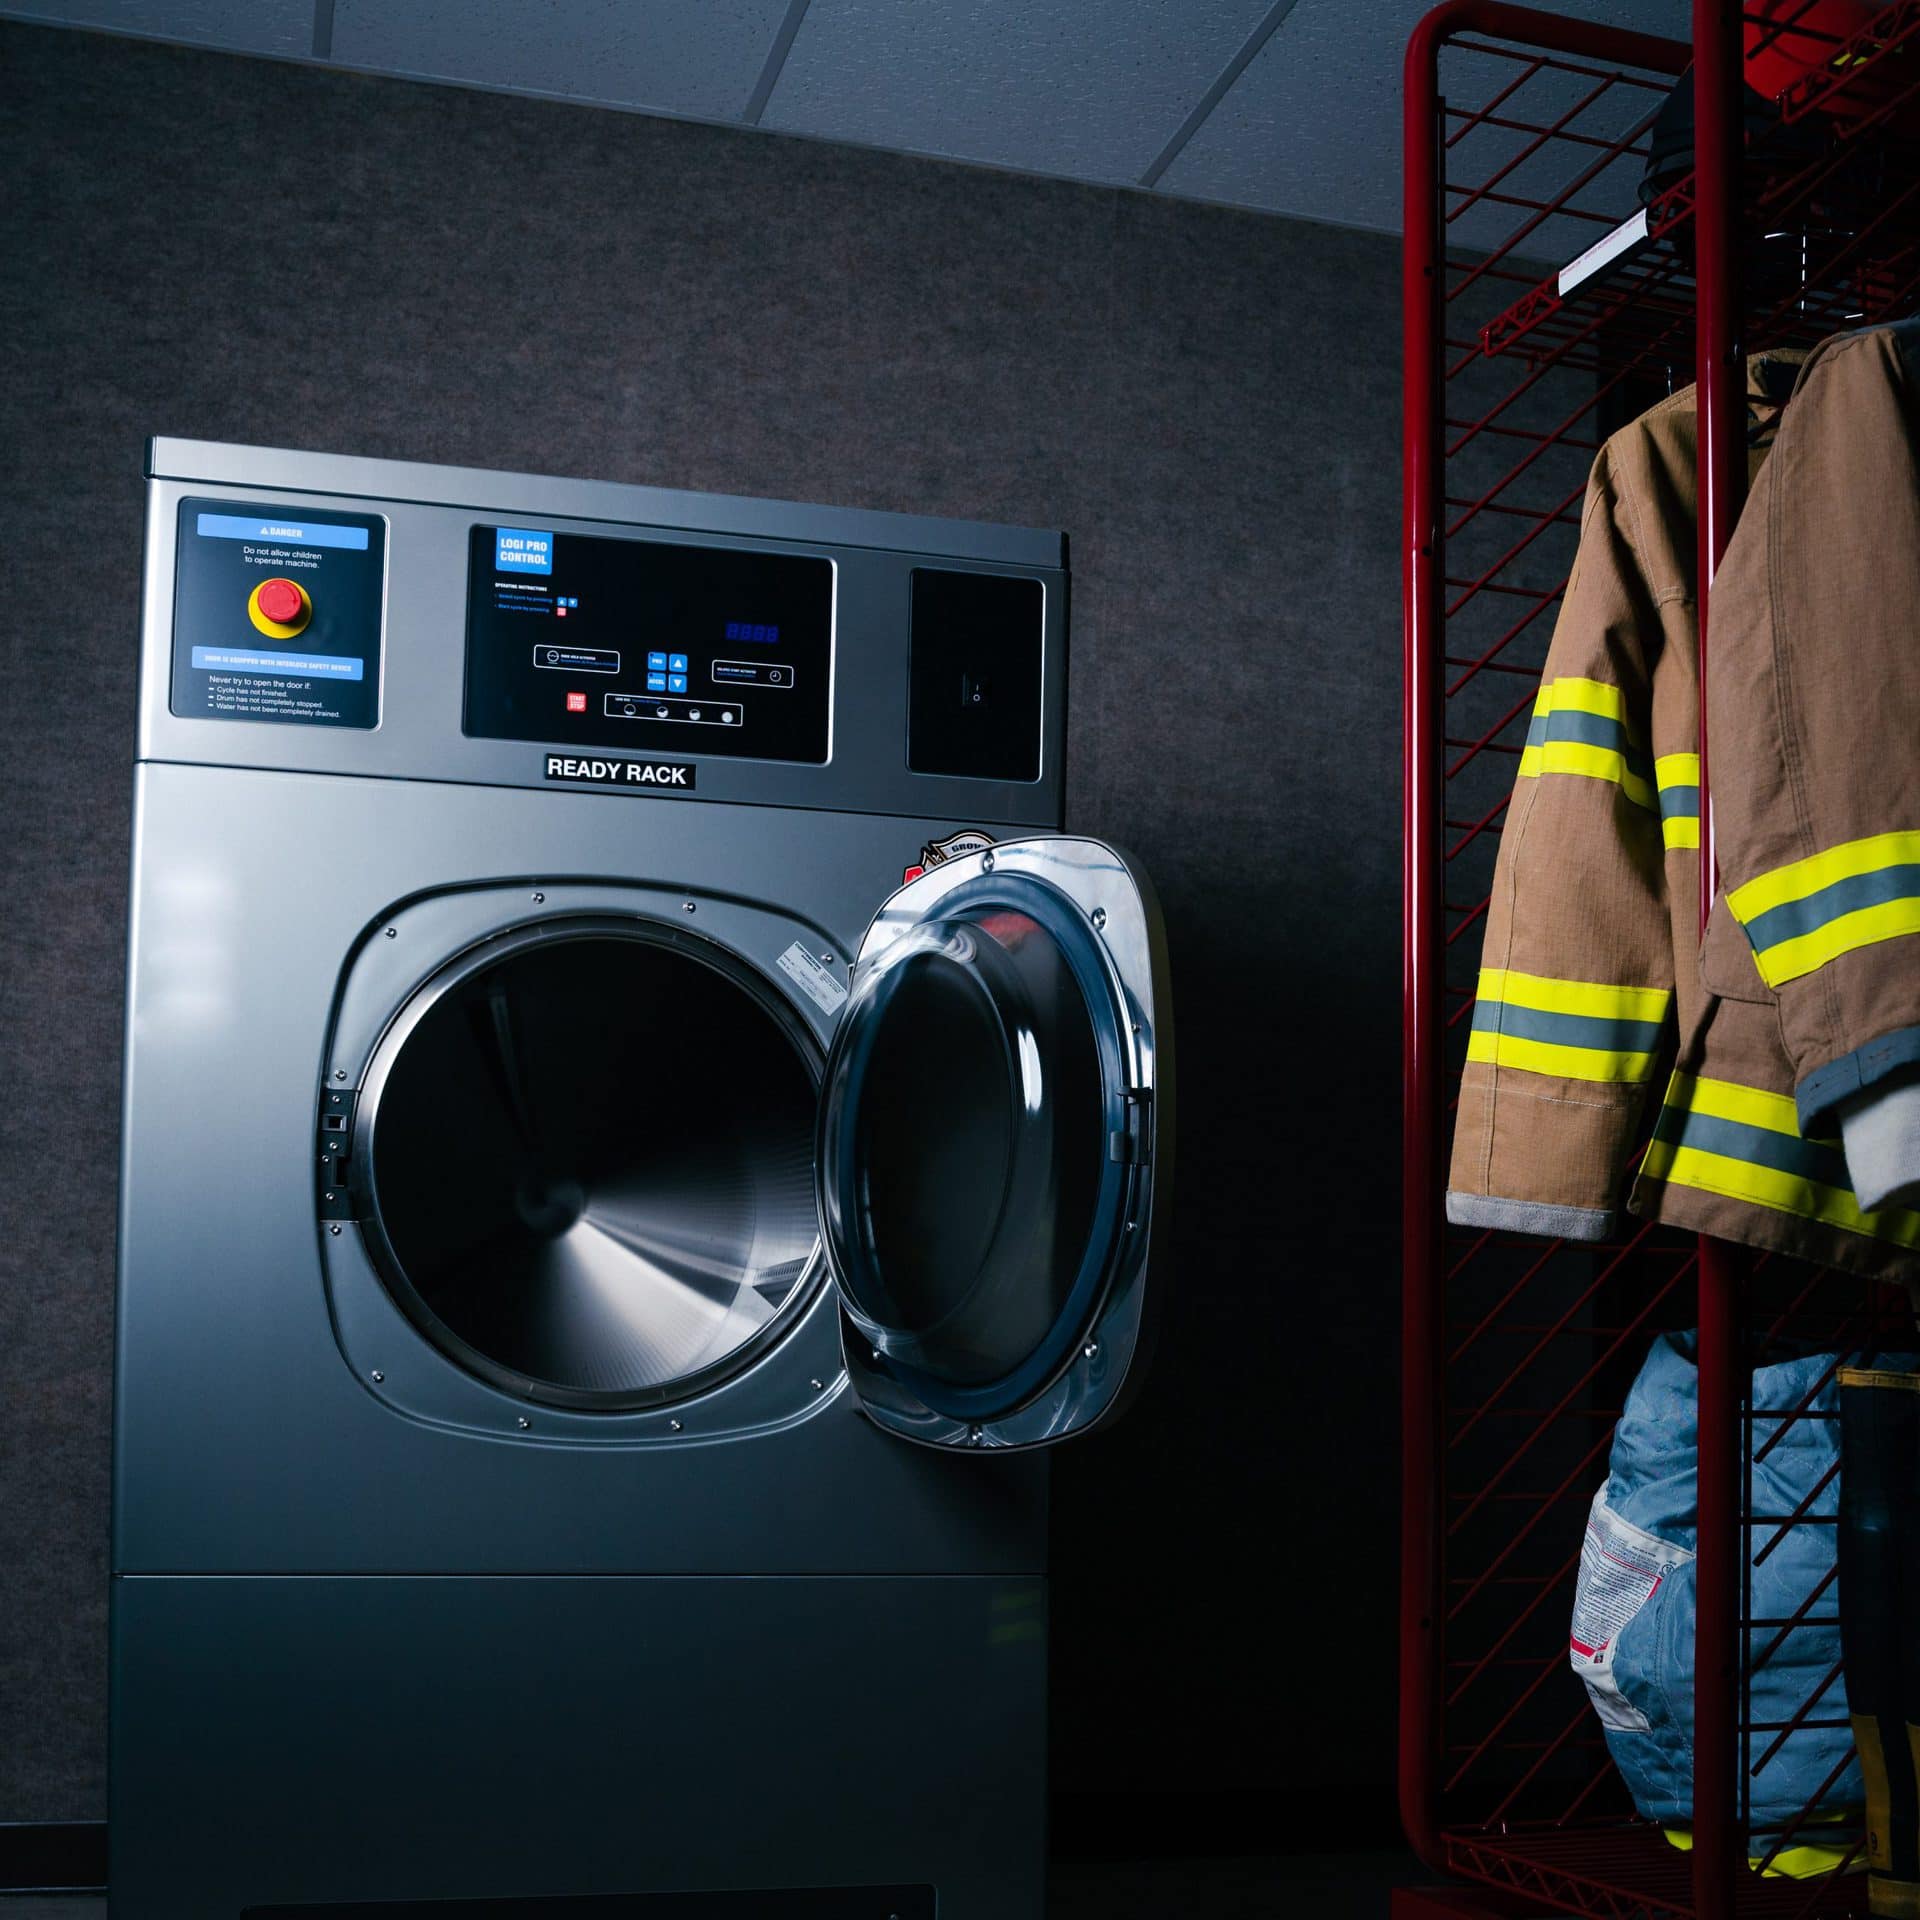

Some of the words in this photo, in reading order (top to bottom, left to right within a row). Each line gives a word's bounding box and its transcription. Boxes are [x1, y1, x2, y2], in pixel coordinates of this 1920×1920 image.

[270, 527, 304, 538] DANGER
[501, 538, 524, 550] LOGI
[526, 540, 548, 552] PRO
[243, 546, 255, 554] Do
[256, 548, 269, 556] not
[270, 549, 291, 558] allow
[292, 550, 322, 560] children
[500, 551, 548, 565] CONTROL
[254, 557, 283, 566] operate
[285, 560, 320, 569] machine.
[209, 675, 232, 684] Never
[233, 677, 243, 686] try
[244, 678, 252, 686] to
[253, 680, 272, 689] open
[273, 679, 285, 688] the
[286, 681, 303, 689] door
[216, 686, 235, 694] Cycle
[236, 687, 249, 695] has
[216, 694, 235, 702] Drum
[261, 698, 296, 708] completely
[262, 705, 278, 714] been
[279, 707, 314, 717] completely
[548, 758, 621, 780] READY
[626, 764, 687, 785] RACK
